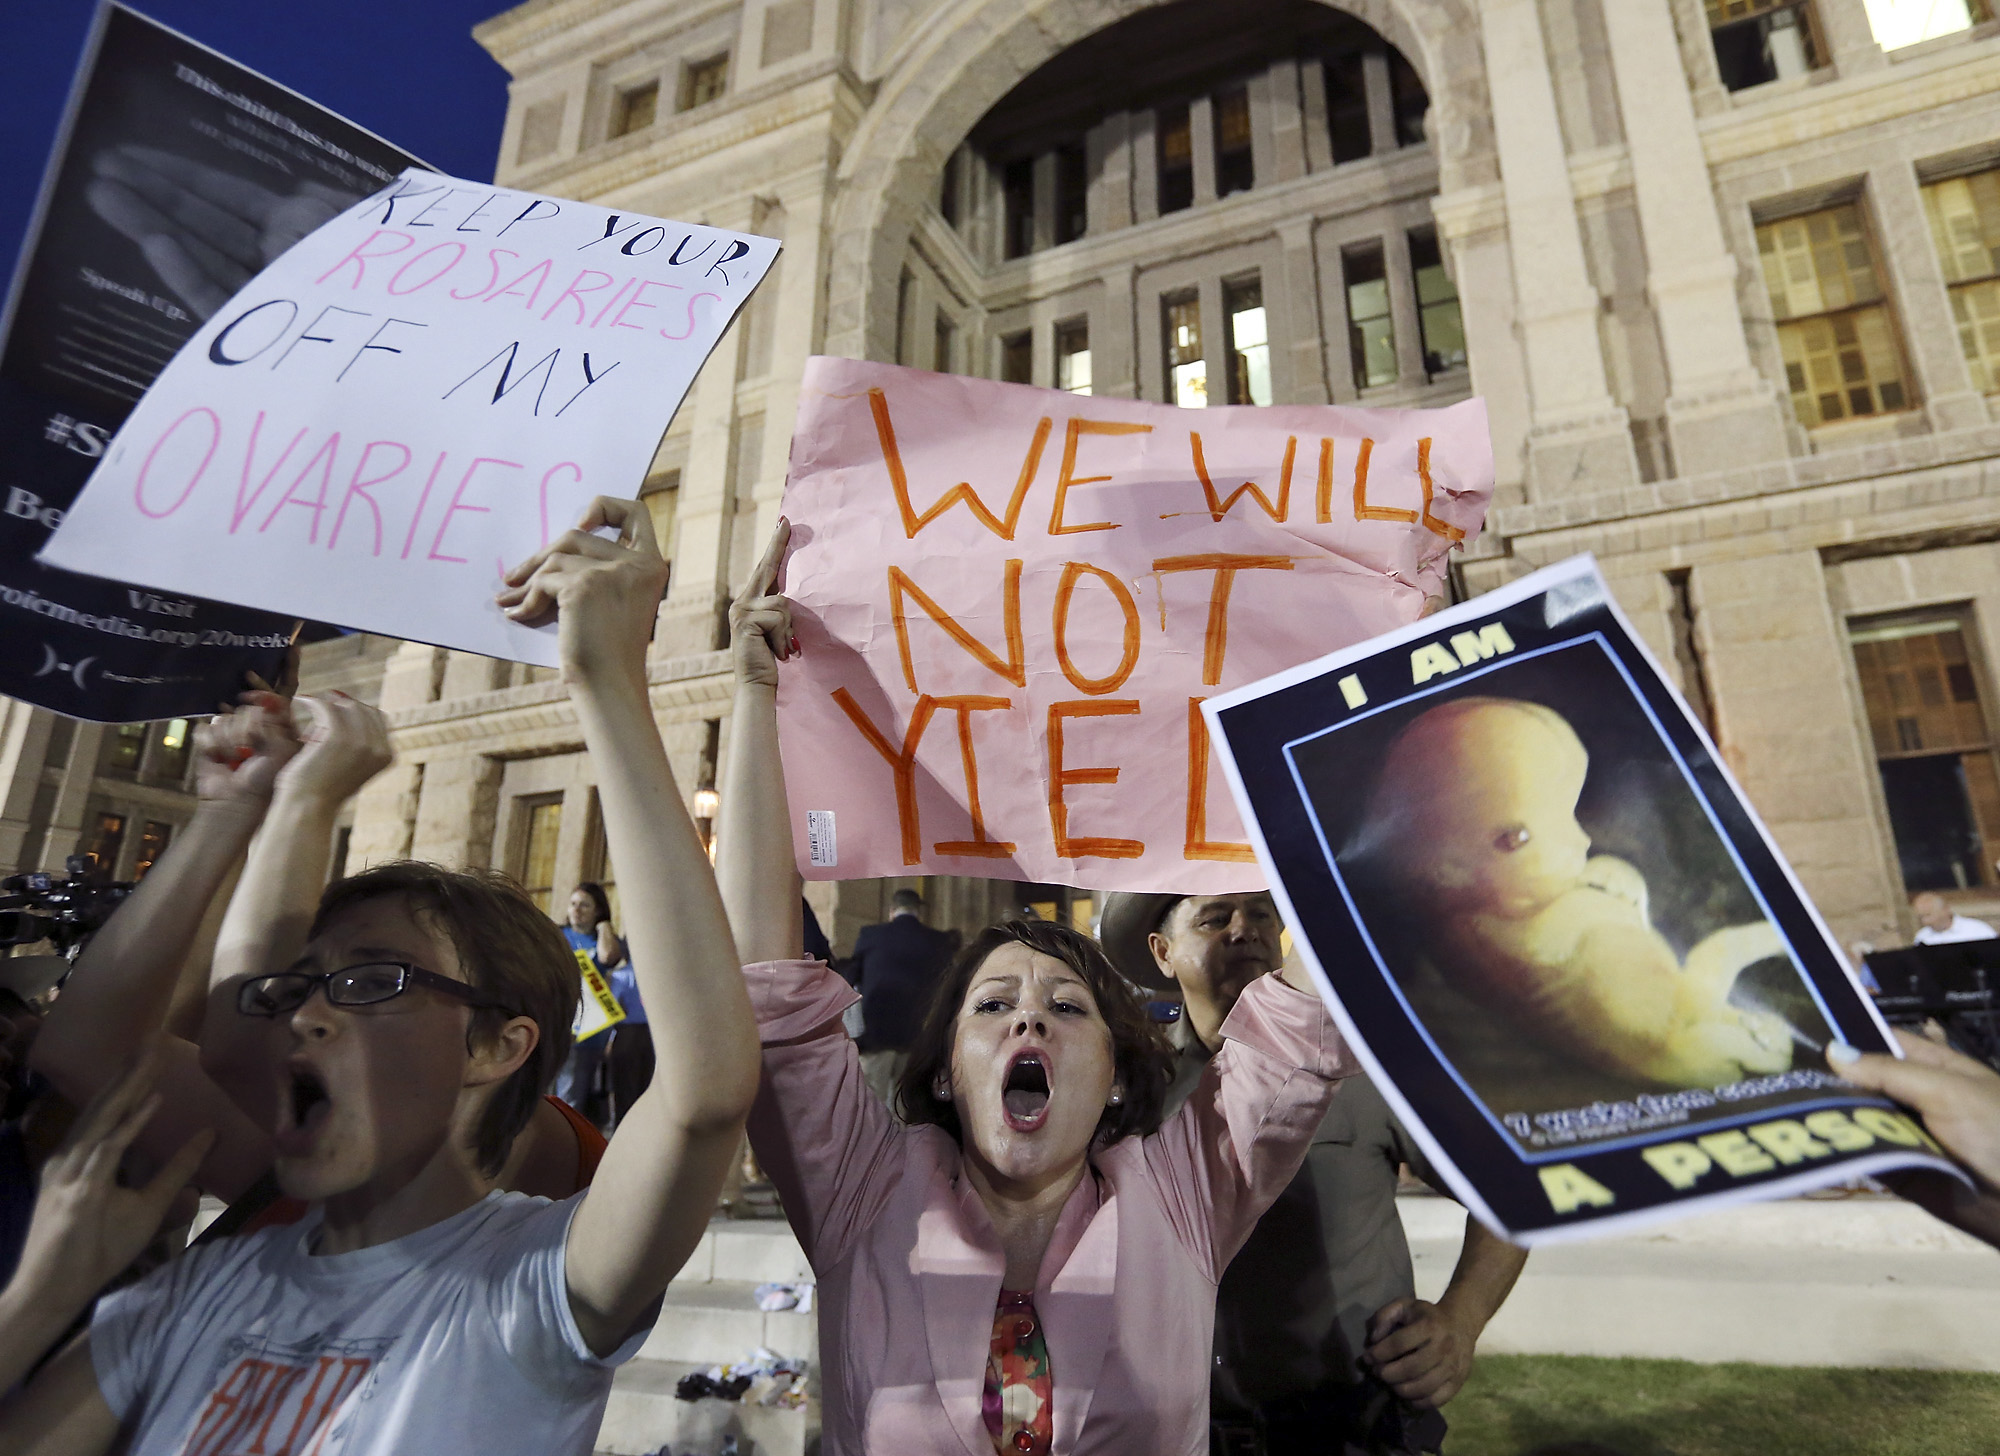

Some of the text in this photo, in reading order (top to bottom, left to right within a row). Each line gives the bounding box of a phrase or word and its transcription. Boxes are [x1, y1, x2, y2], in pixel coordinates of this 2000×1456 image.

[315, 230, 722, 341] ROSARIES
[358, 178, 750, 287] KEEP YOUR
[208, 299, 429, 383] OFF
[442, 341, 621, 417] MY
[44, 411, 113, 458] #S
[134, 406, 583, 573] OVARIES
[868, 386, 1467, 542] WE WILL
[3, 485, 66, 530] Be
[127, 588, 197, 619] Visit
[887, 553, 1296, 696] NOT
[1337, 621, 1516, 710] I AM
[830, 686, 1259, 866] YIEL
[1538, 1162, 1615, 1215] A
